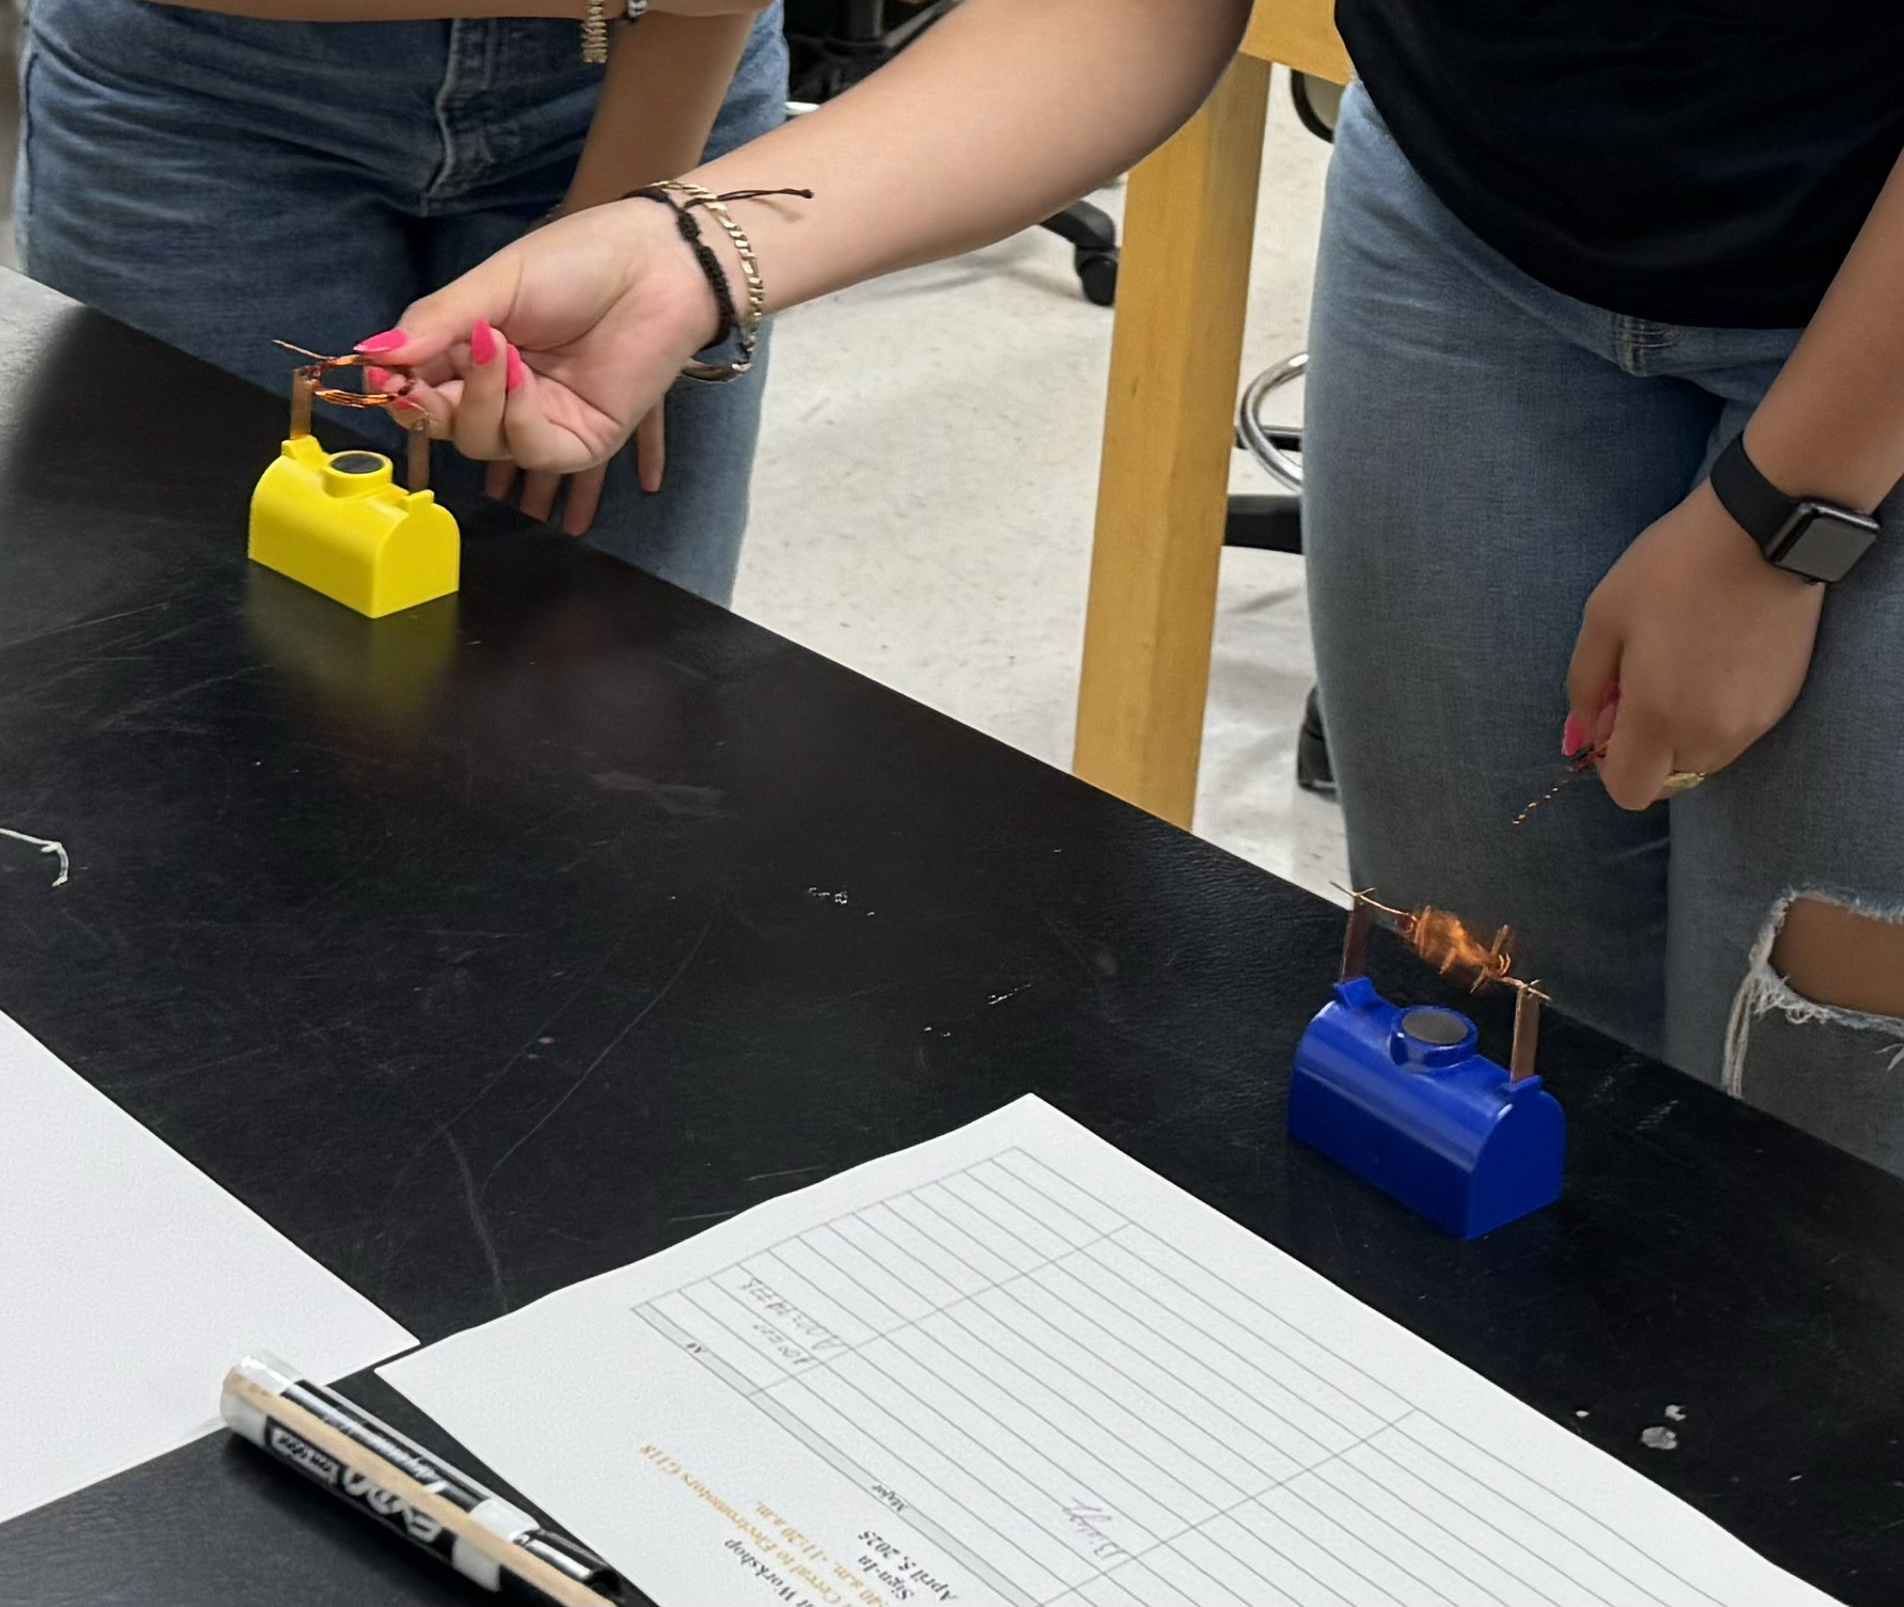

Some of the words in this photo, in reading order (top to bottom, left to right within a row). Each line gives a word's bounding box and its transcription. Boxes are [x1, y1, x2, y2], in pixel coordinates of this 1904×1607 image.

[871, 1483, 911, 1512] Major
[858, 1530, 900, 1558] 2025
[724, 1538, 797, 1603] Workshop
[858, 1554, 915, 1601] Sign-In
[910, 1569, 958, 1602] April
